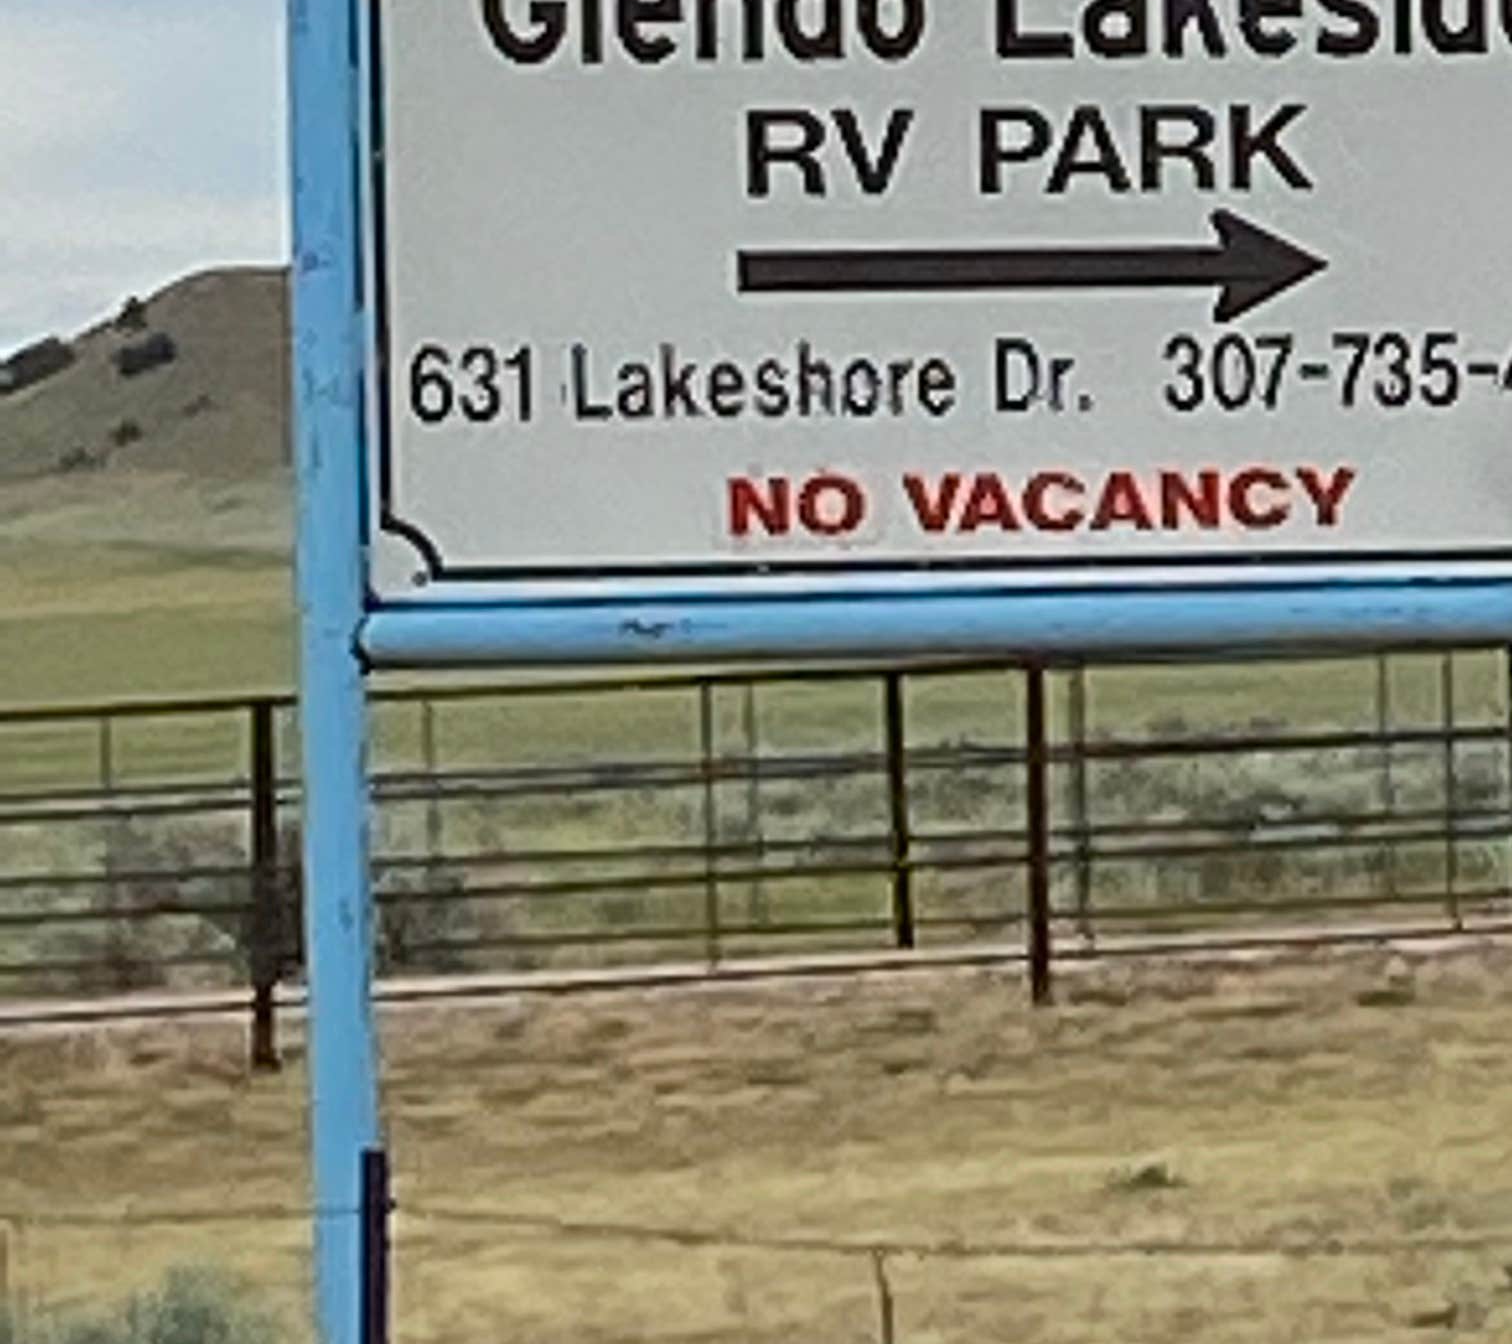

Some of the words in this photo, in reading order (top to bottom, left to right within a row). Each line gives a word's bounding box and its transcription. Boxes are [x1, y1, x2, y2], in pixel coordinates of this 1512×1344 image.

[745, 106, 916, 200] RV
[978, 102, 1316, 196] PARK
[408, 343, 534, 426] 631
[569, 339, 957, 423] Lakeshore
[994, 336, 1094, 414] Dr.
[725, 472, 866, 540] NO
[901, 464, 1357, 535] VACANCY
